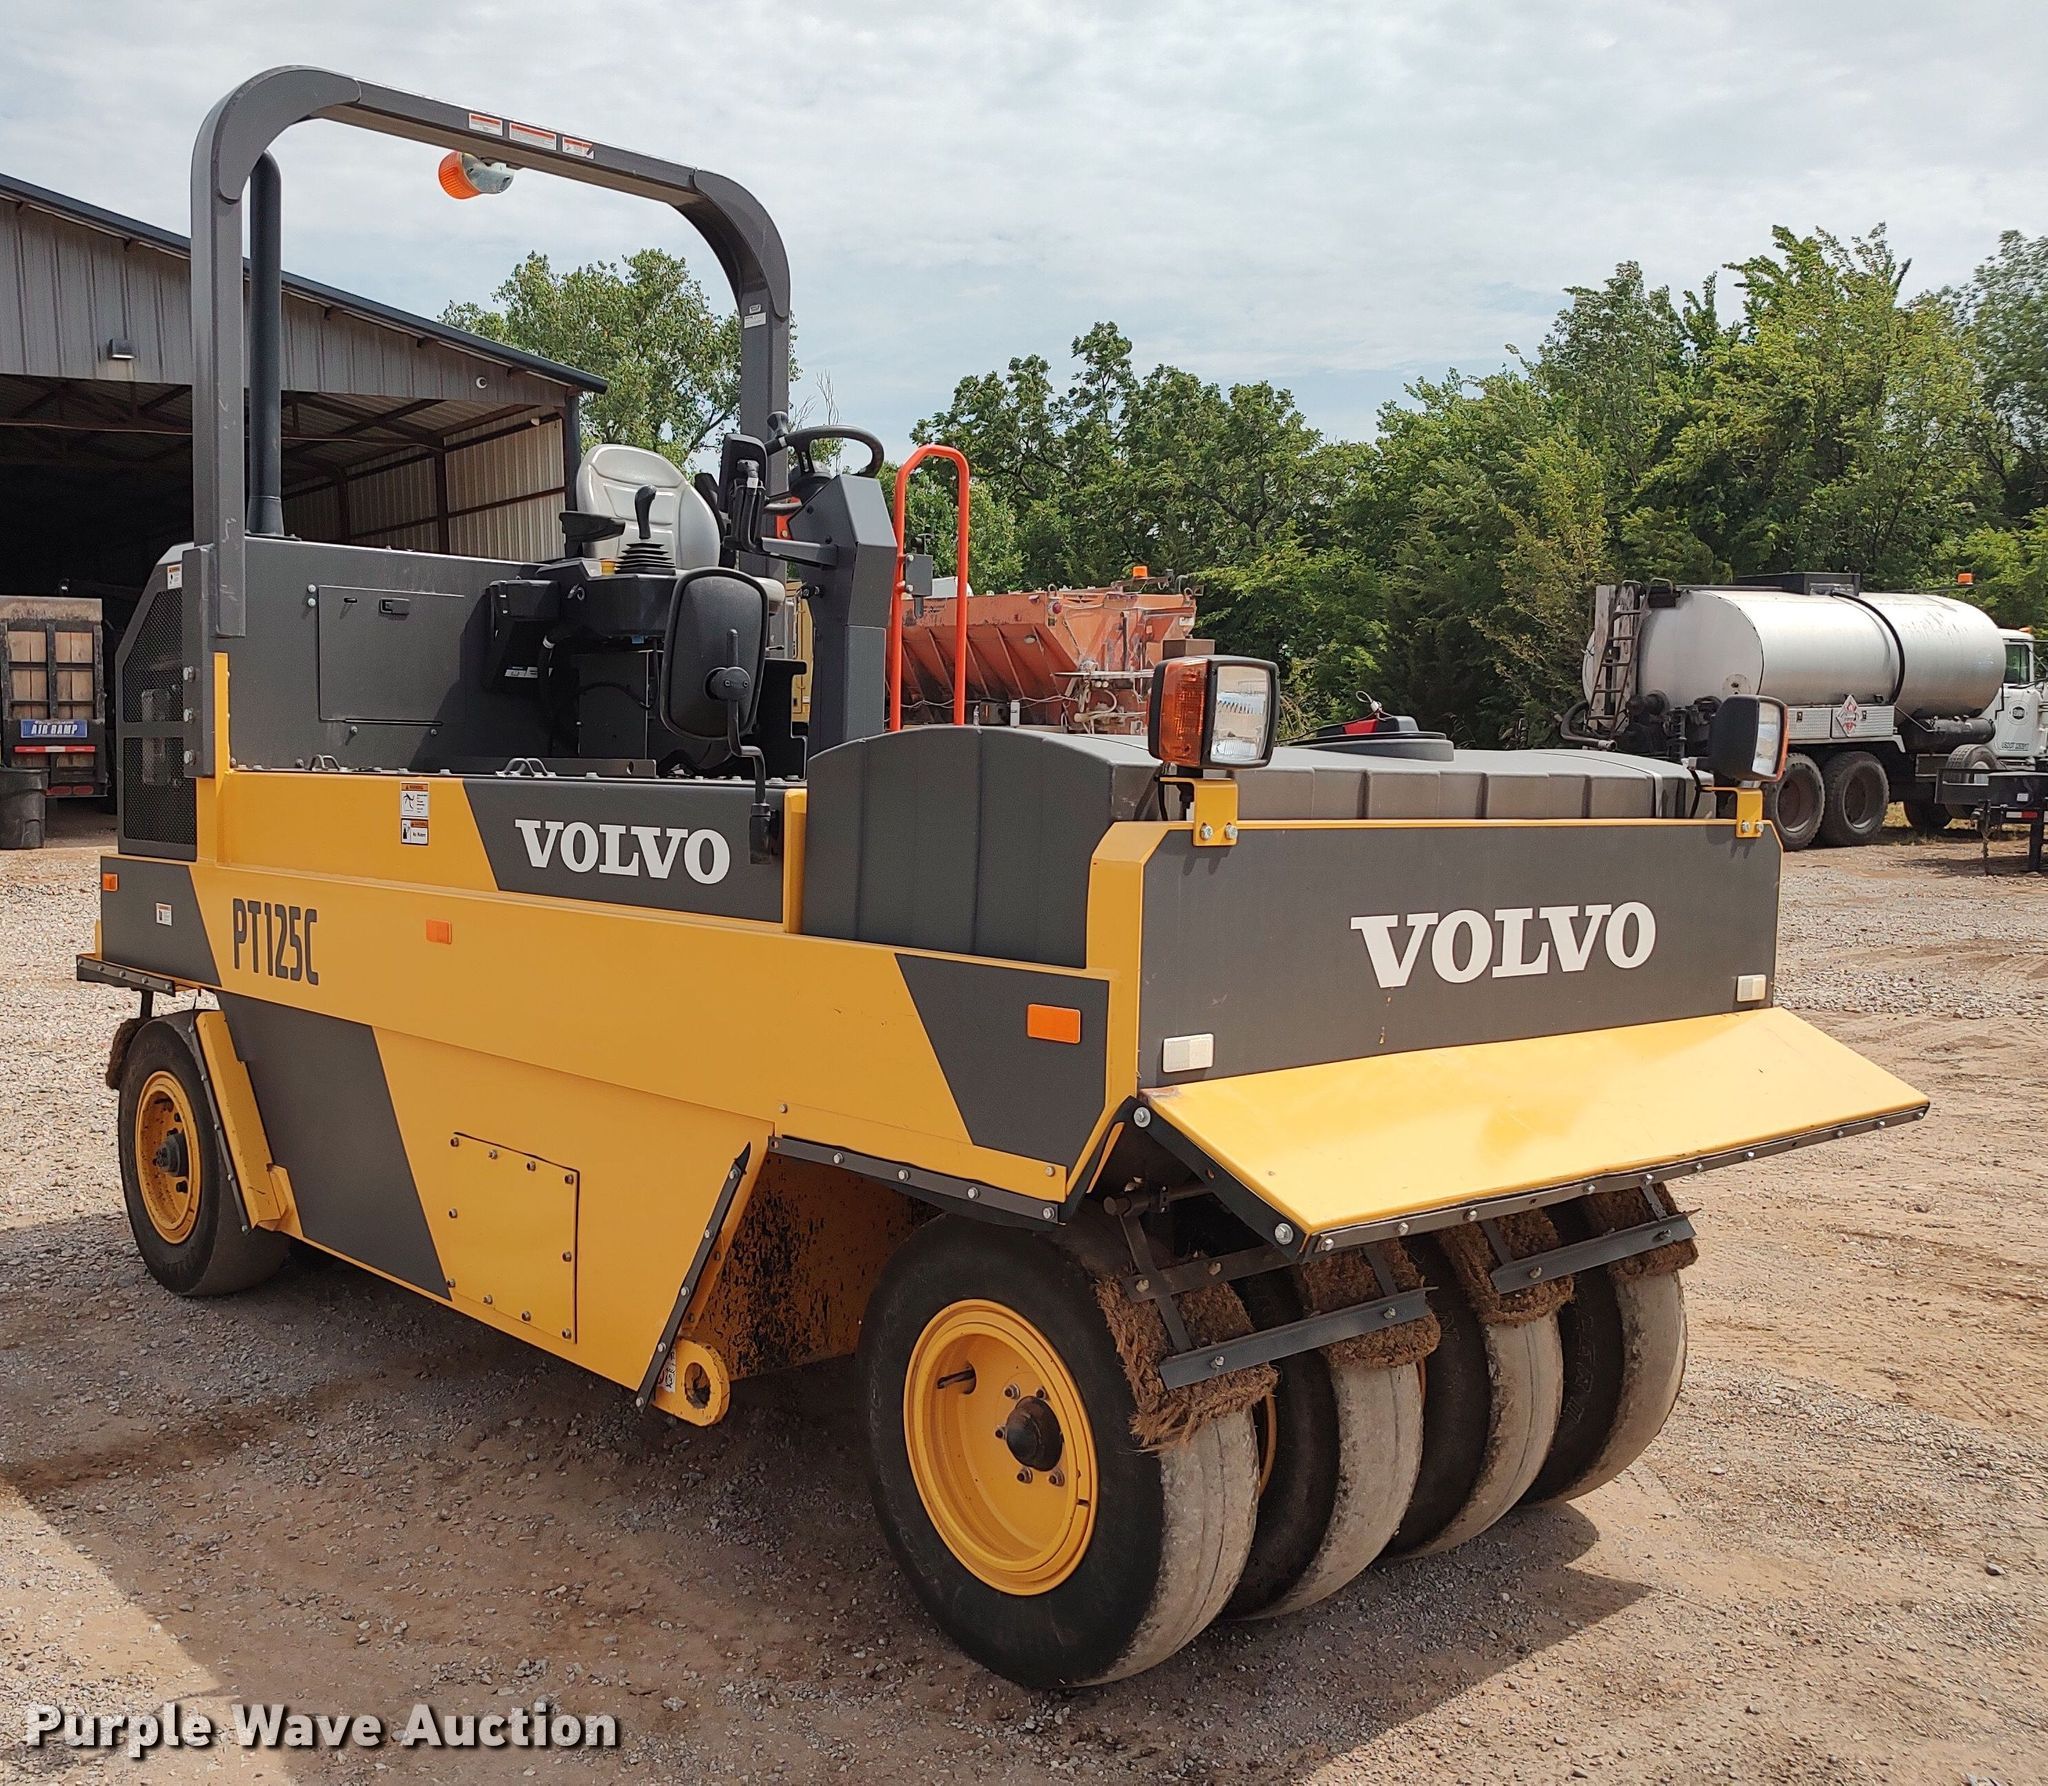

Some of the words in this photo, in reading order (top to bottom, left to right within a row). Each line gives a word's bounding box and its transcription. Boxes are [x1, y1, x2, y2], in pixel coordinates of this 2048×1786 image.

[31, 724, 48, 735] AIR
[515, 819, 730, 885] VOLVO
[233, 897, 319, 986] PT125C
[1351, 901, 1656, 988] VOLVO
